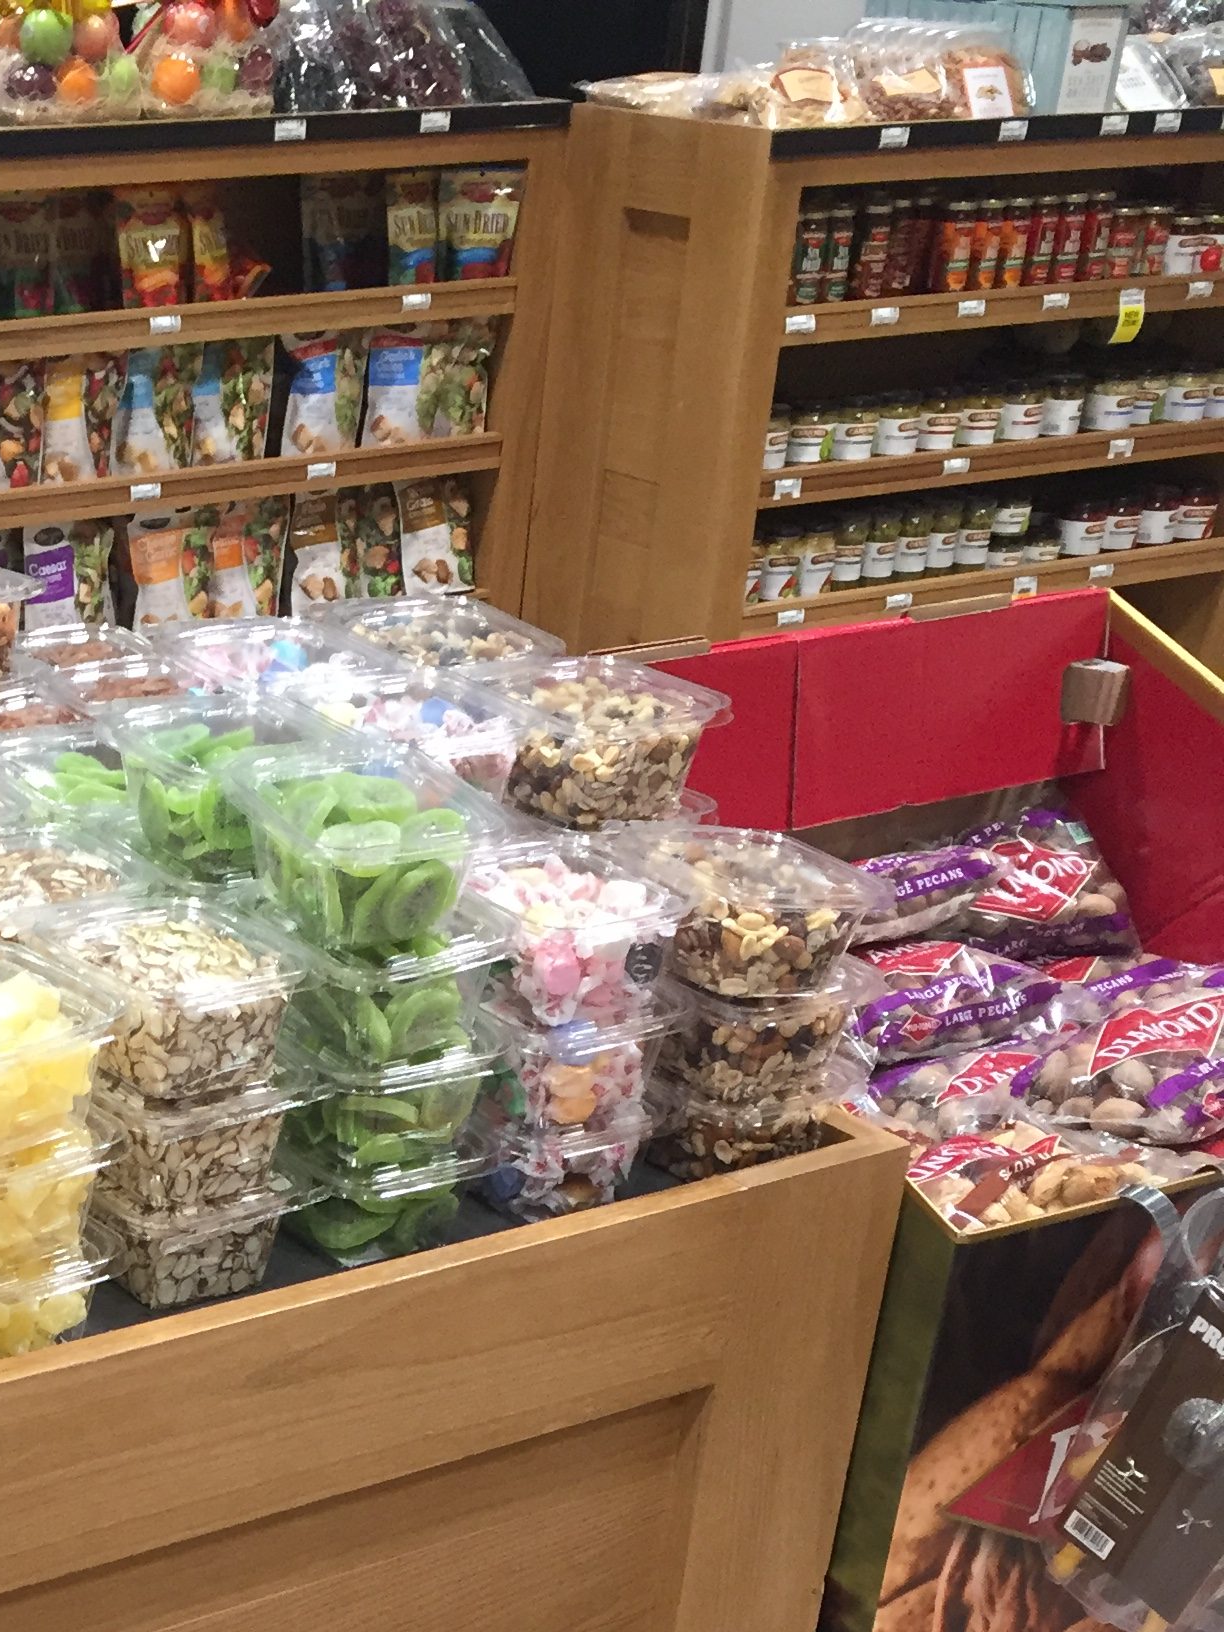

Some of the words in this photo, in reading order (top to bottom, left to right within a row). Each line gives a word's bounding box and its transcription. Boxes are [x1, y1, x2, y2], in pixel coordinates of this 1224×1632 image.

[29, 560, 67, 577] Caesar
[916, 867, 965, 894] PECANS
[1090, 974, 1134, 992] PECANS
[977, 992, 1028, 1018] PECANS
[1096, 1001, 1220, 1060] DIAMOND
